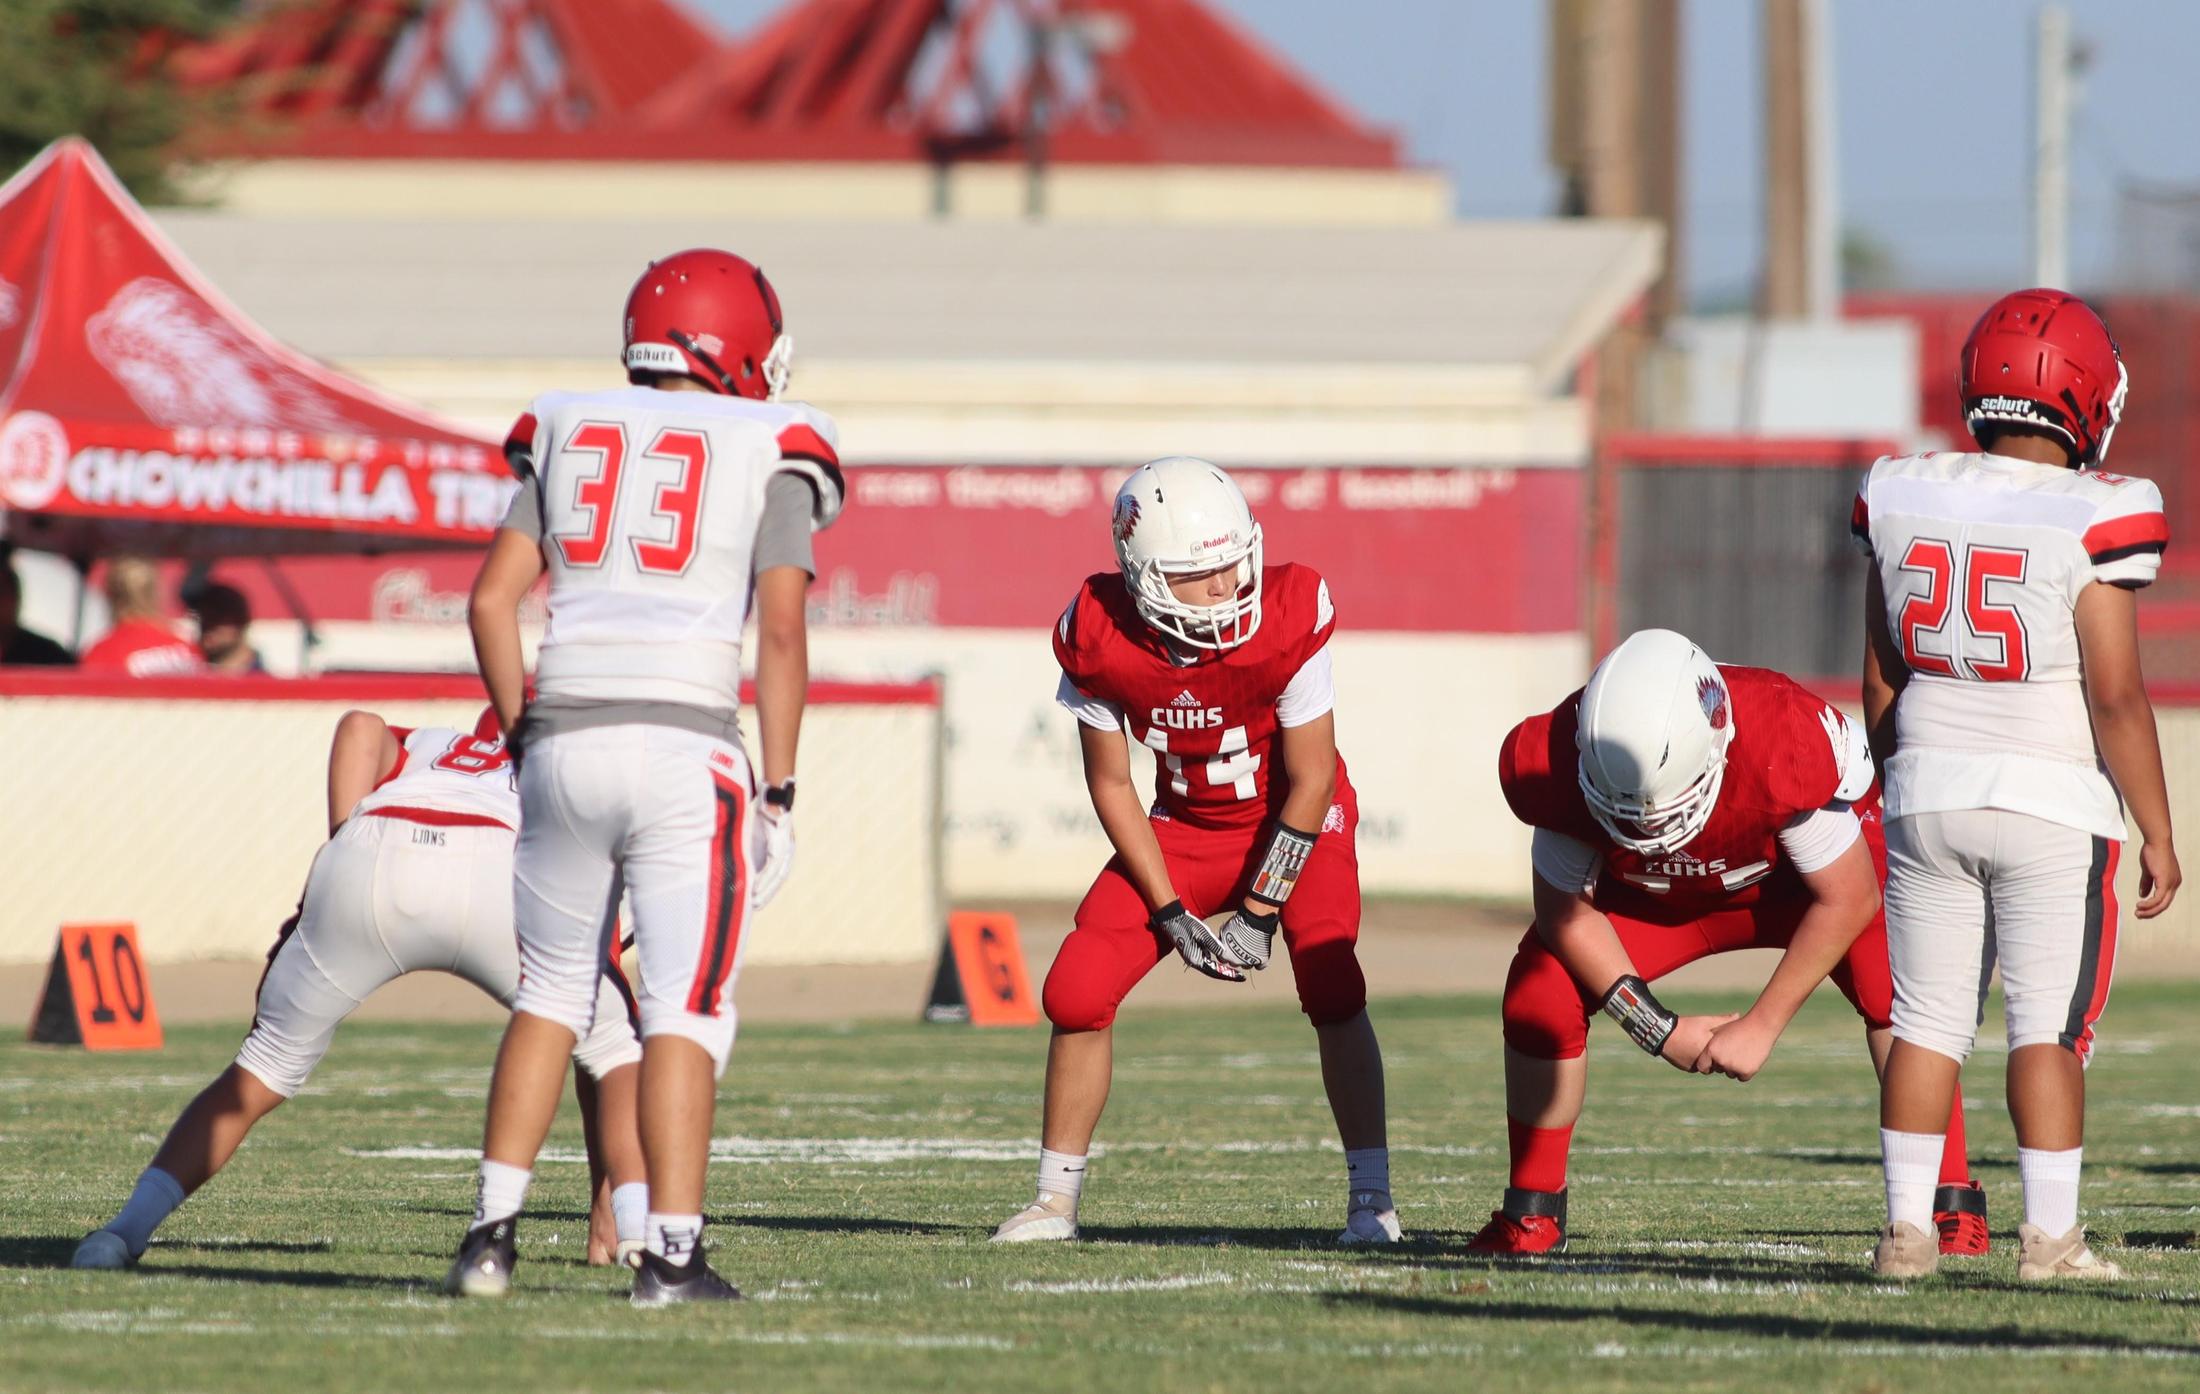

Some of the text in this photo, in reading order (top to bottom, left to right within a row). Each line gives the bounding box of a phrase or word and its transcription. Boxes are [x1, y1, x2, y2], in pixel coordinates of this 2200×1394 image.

[629, 347, 676, 361] schutt
[1981, 395, 2031, 413] schutt
[66, 446, 418, 523] CHOWCHILLA
[554, 420, 711, 577] 33
[1202, 533, 1229, 549] Riddell
[1899, 537, 2028, 682] 25
[1151, 706, 1223, 729] CUHS
[1143, 724, 1261, 800] 14
[412, 829, 446, 847] LIONS
[79, 932, 145, 1024] 10
